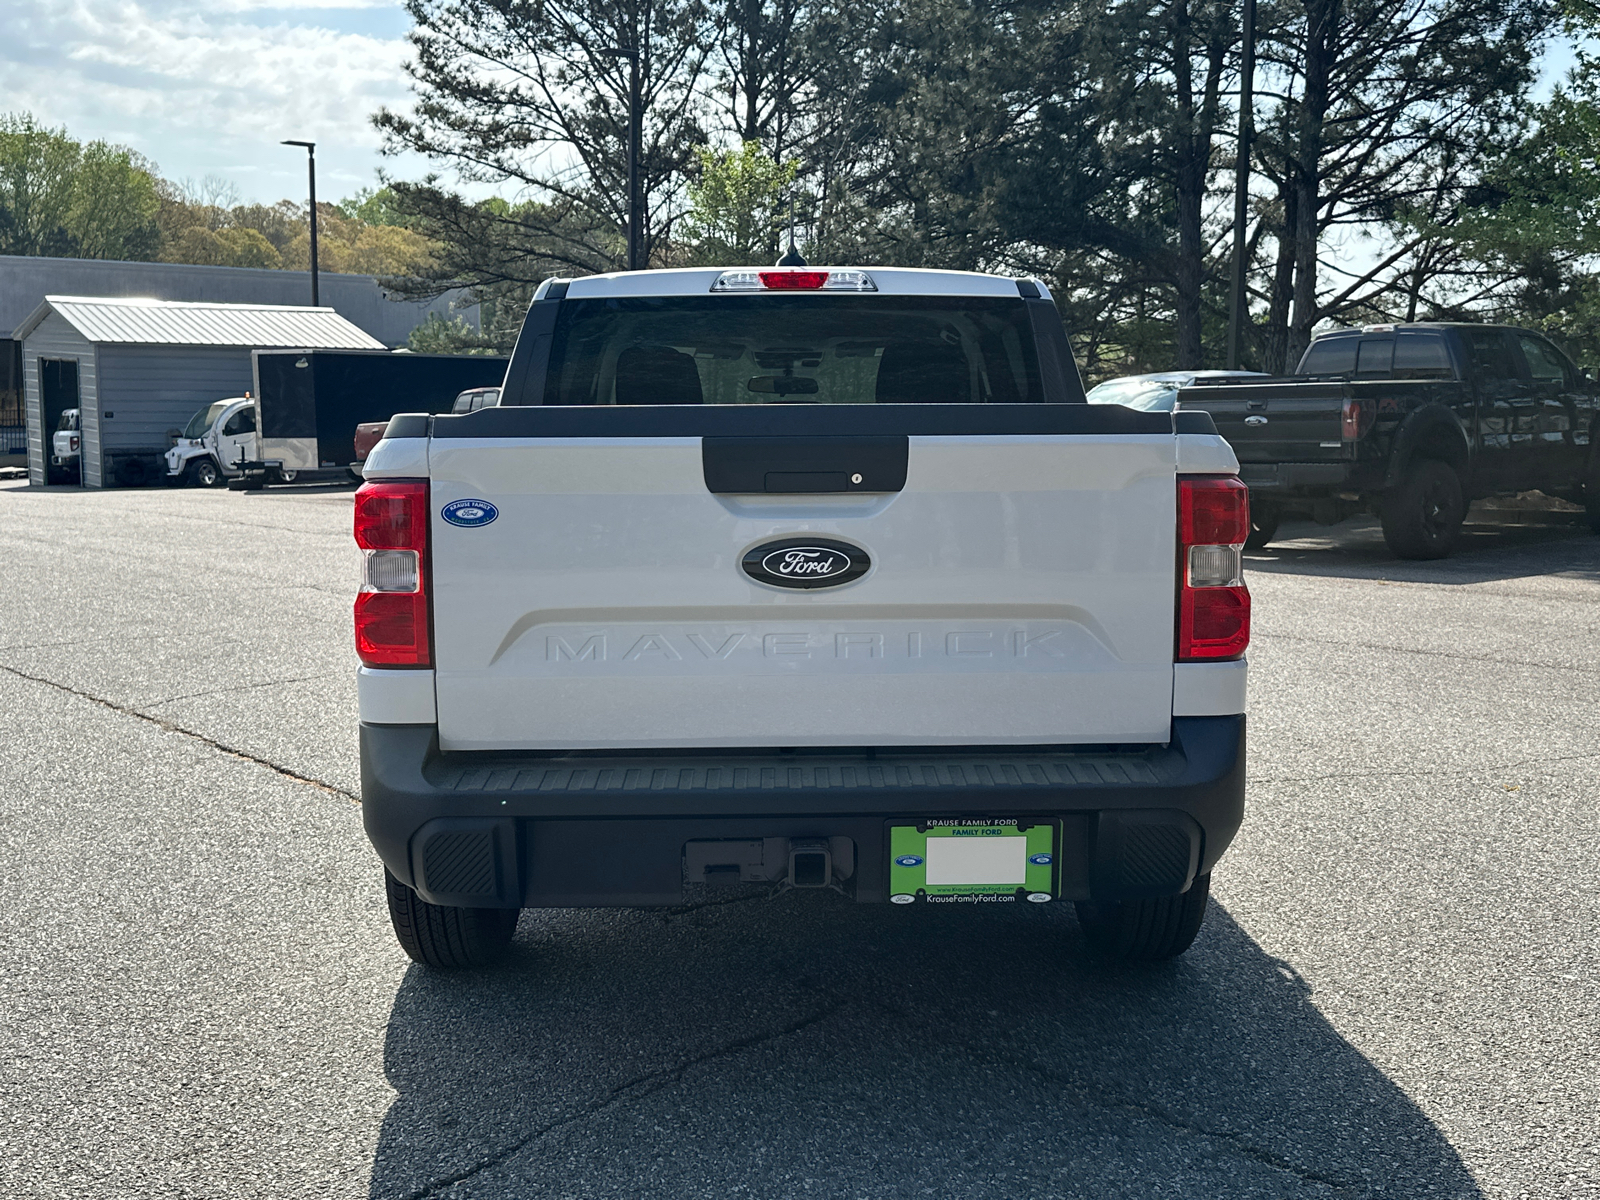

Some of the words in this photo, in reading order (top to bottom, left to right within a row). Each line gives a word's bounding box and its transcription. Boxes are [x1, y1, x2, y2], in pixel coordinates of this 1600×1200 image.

[450, 502, 470, 511] KRAUSE
[472, 502, 491, 510] FAMILY
[462, 509, 478, 517] Ford
[780, 551, 833, 573] Ford
[546, 630, 1065, 661] MAVERICK
[927, 894, 1015, 904] KrauseFamilyFord.com
